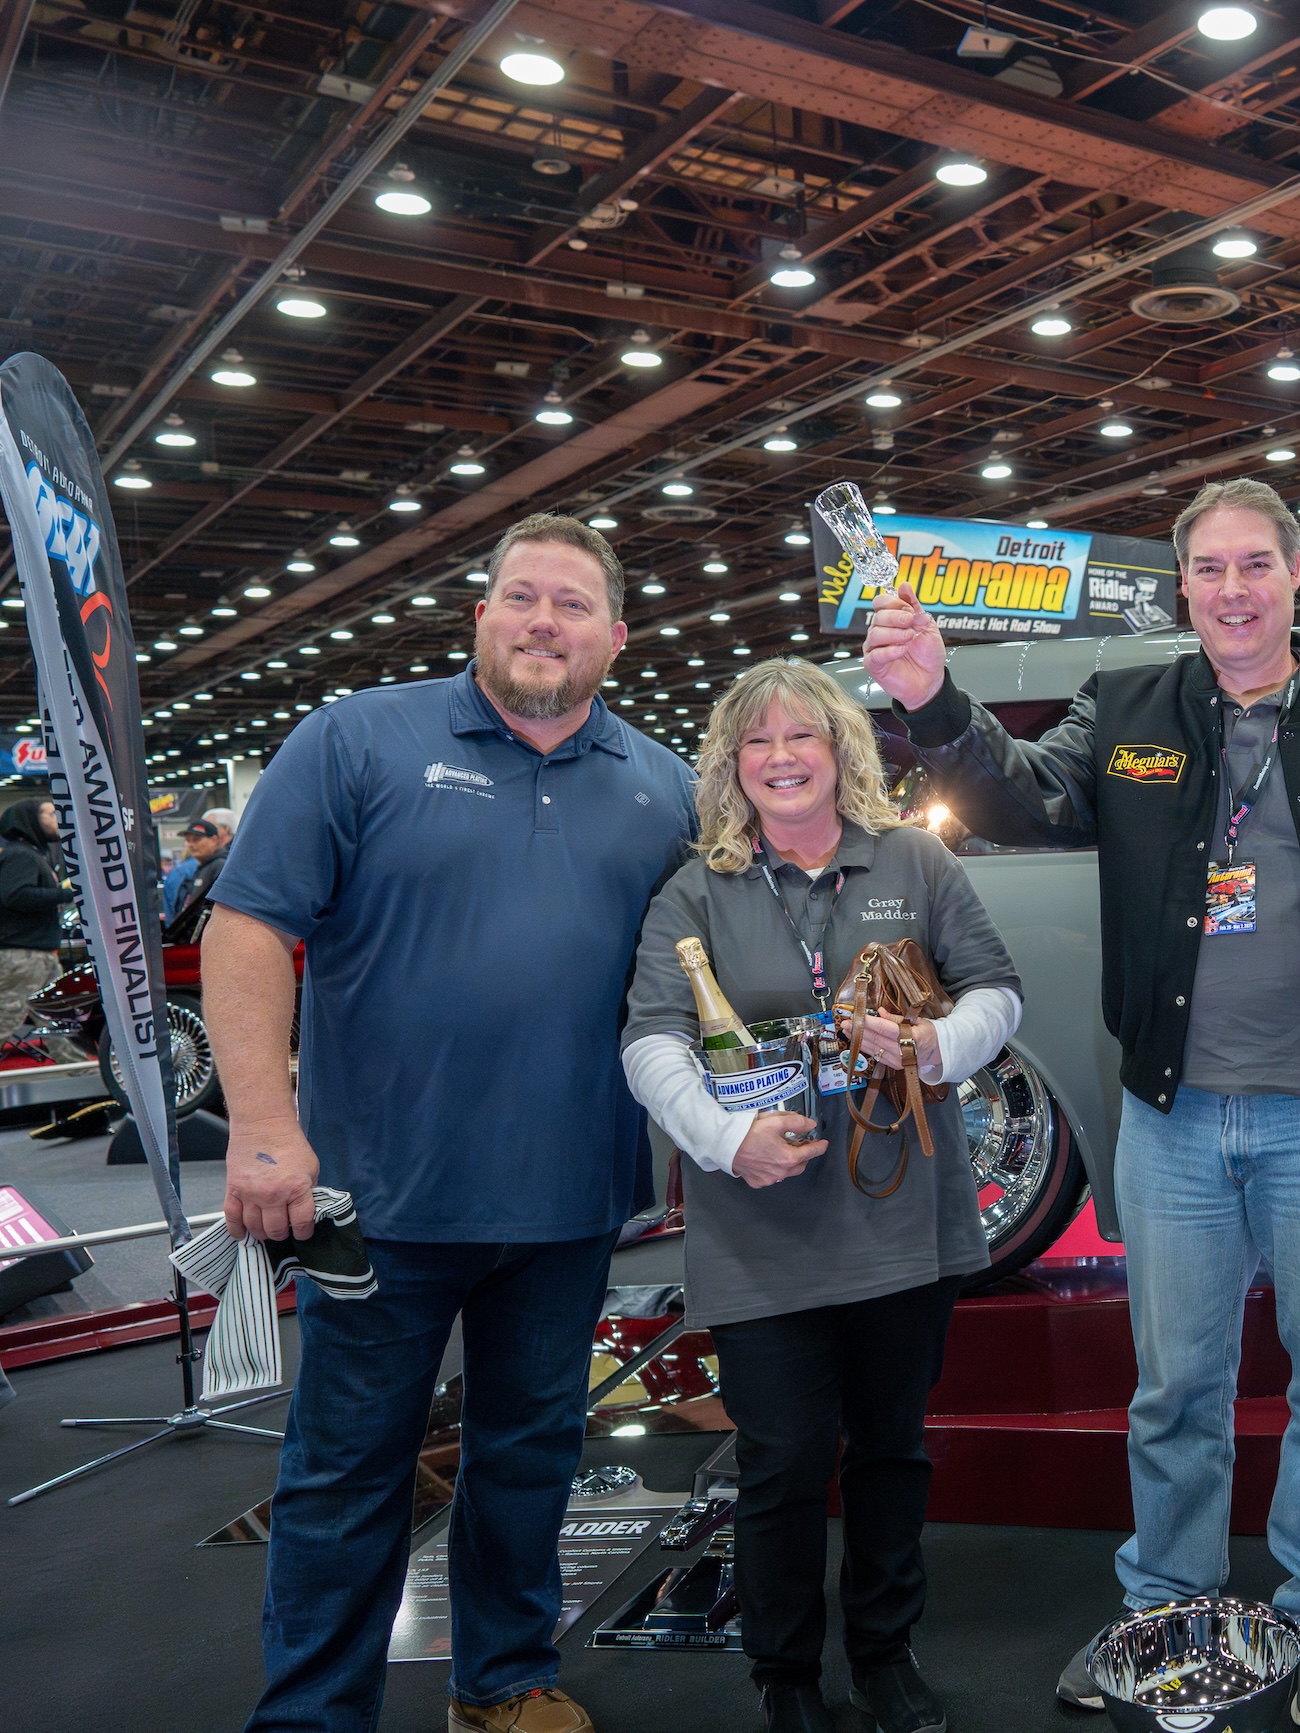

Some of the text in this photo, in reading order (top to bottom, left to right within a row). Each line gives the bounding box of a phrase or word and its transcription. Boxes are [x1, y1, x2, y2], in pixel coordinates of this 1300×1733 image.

[996, 536, 1066, 560] Detroit
[818, 551, 854, 606] Welc
[1088, 568, 1106, 576] HOME
[1116, 571, 1127, 579] THE
[1089, 577, 1136, 601] Ridler
[1089, 601, 1119, 612] AWARD
[936, 614, 1061, 634] Greatest Hot Rod Show
[1114, 749, 1179, 777] Meguiar's
[79, 739, 128, 893] AWARD
[868, 898, 904, 909] Gray
[860, 909, 917, 921] Madder
[111, 902, 158, 1060] FINALIST
[717, 1068, 790, 1096] ADVANCED PLATING
[559, 1520, 651, 1537] ADDER
[655, 1634, 687, 1643] RIDLER
[689, 1635, 726, 1644] BUILDER
